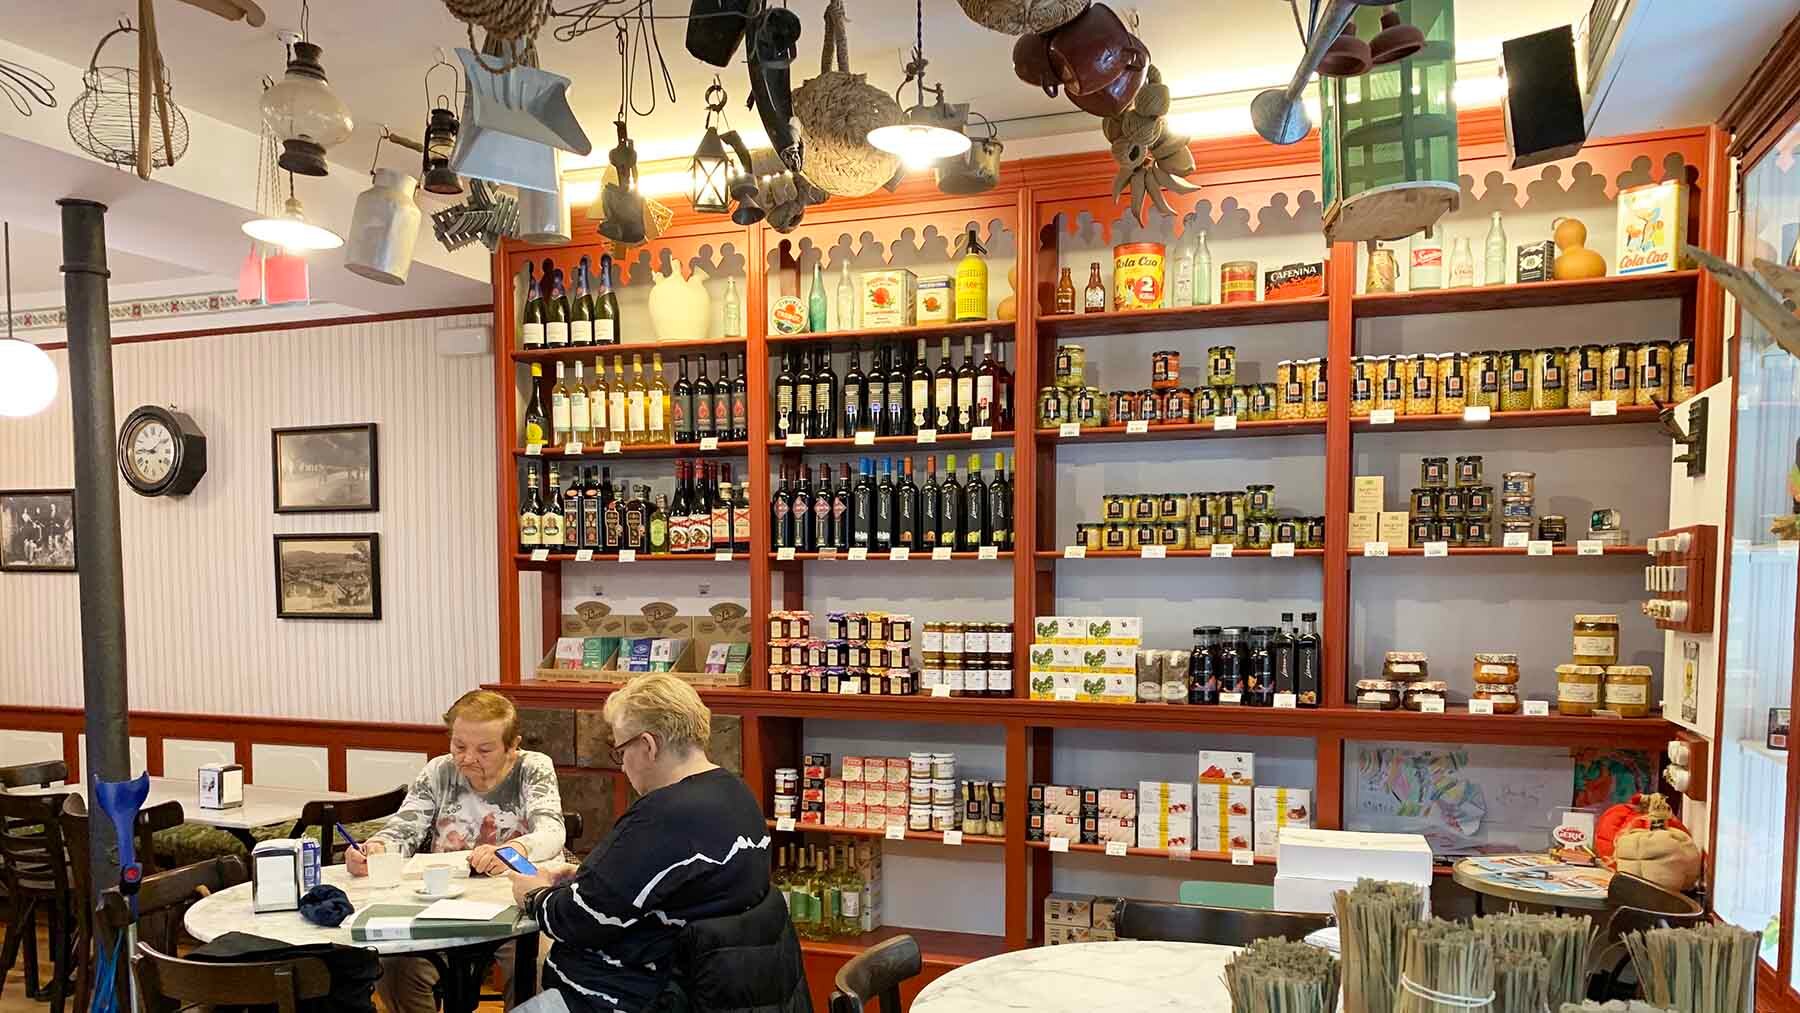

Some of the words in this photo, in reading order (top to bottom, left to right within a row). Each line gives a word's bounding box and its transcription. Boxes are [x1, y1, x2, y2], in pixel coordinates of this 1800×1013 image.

[1138, 255, 1158, 266] Cao
[1620, 254, 1646, 268] Cola
[1647, 251, 1669, 264] Cao
[1270, 266, 1317, 282] CAFENINA
[1140, 276, 1153, 292] 2
